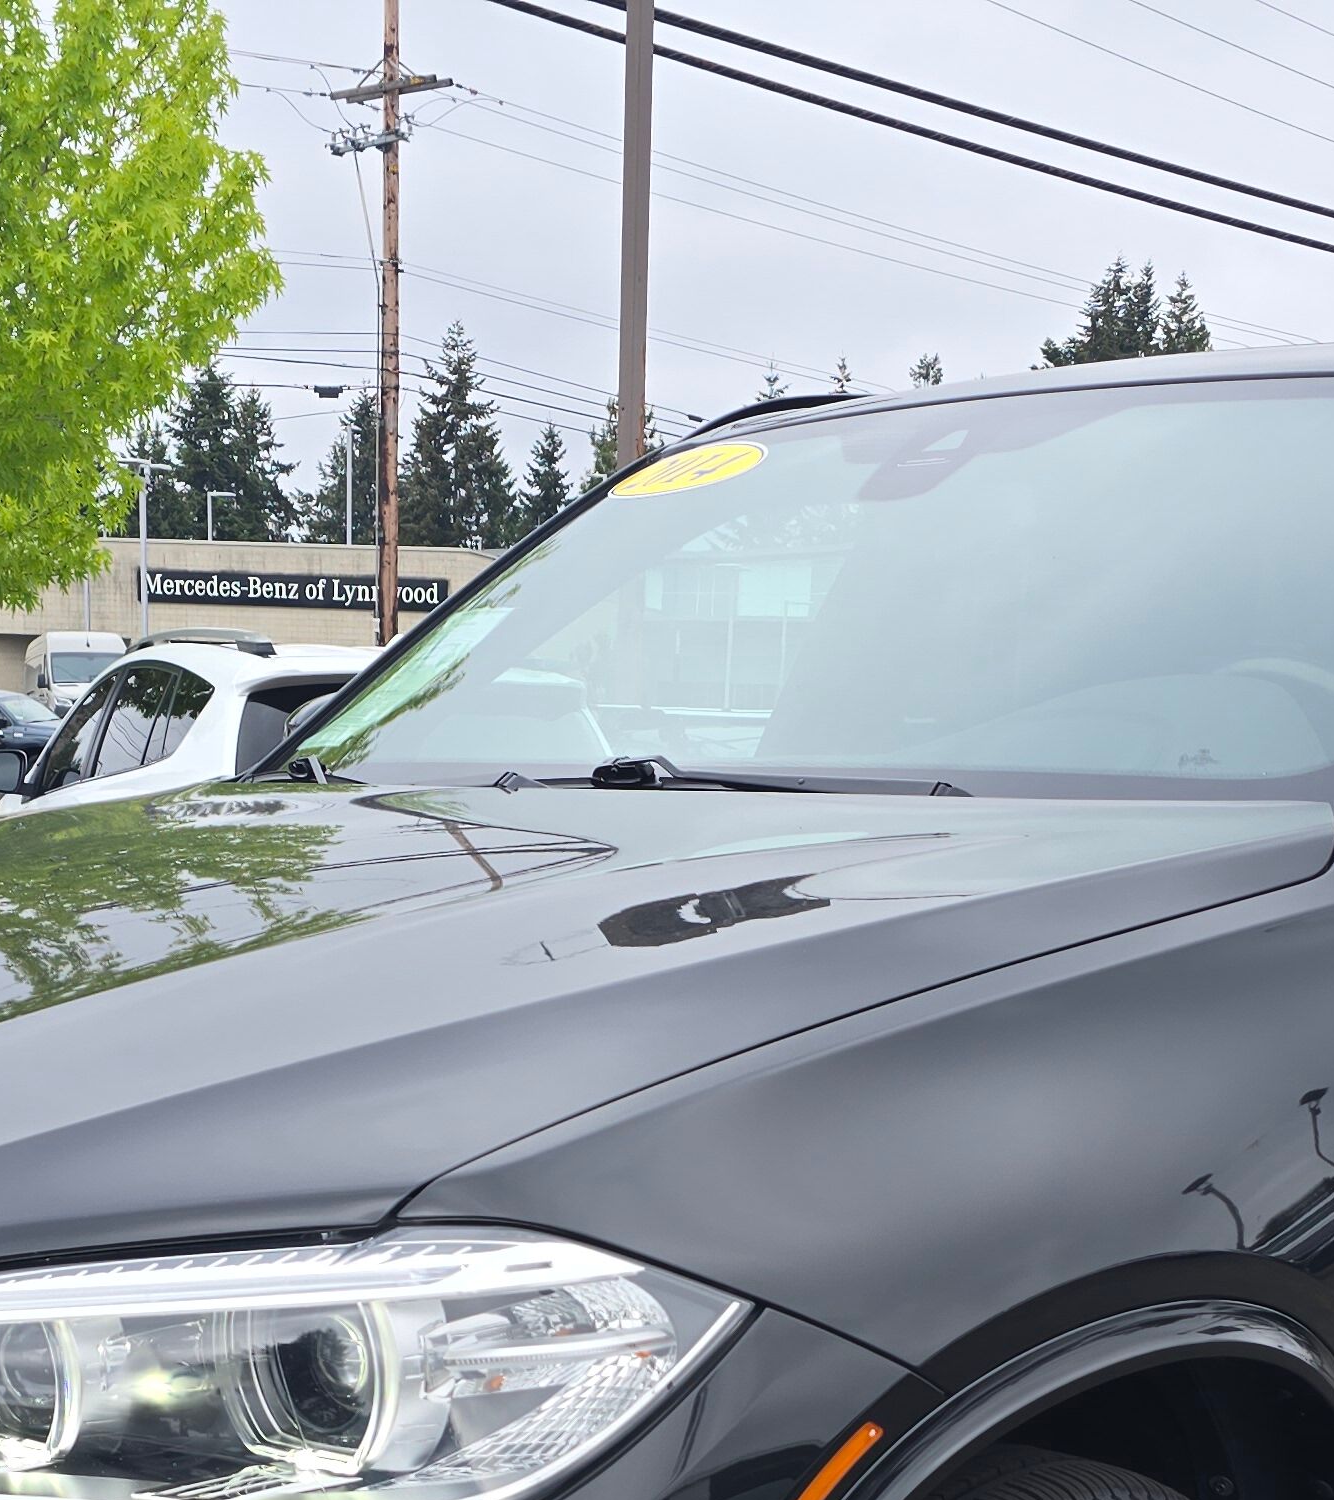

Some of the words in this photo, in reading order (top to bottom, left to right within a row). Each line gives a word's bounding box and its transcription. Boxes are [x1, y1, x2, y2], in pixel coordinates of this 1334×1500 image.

[145, 573, 299, 599] Mercedes-Benz
[305, 578, 327, 600] of
[331, 579, 440, 606] Lynood
